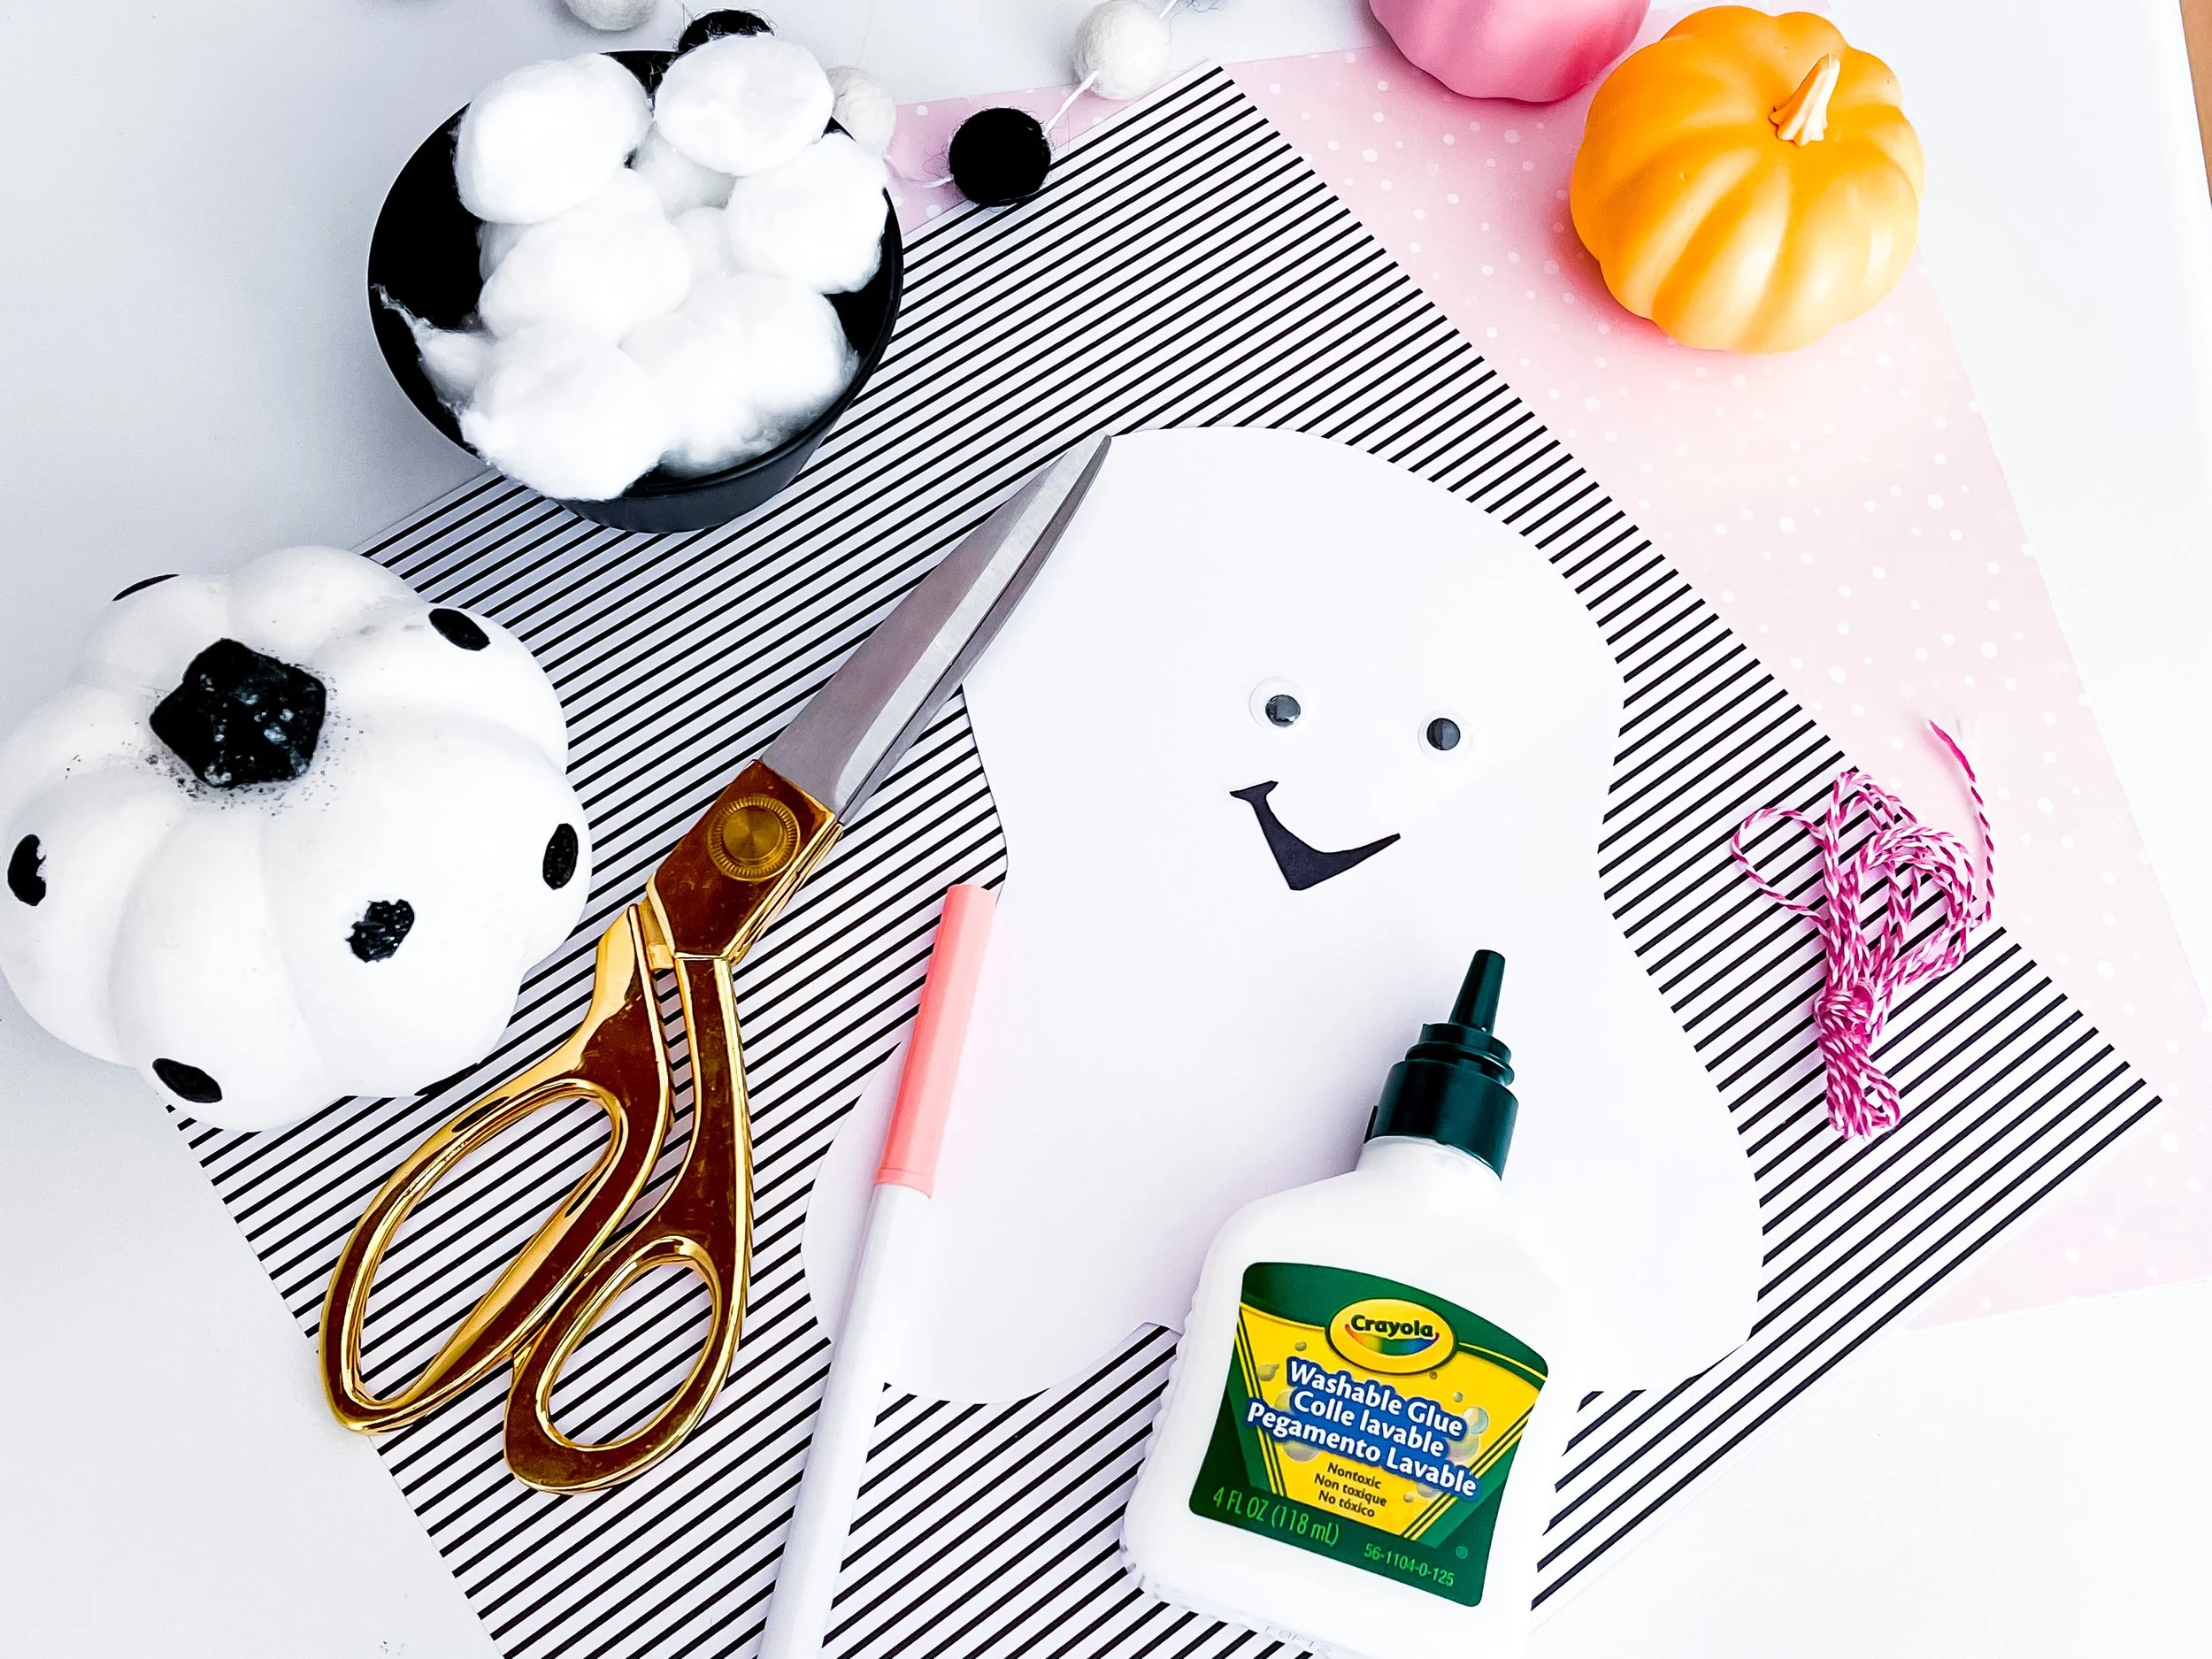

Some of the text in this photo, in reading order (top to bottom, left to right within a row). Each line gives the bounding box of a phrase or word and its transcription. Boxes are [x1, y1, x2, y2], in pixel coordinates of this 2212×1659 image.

[1350, 1314, 1434, 1337] Crayola
[1290, 1360, 1463, 1438] Washable Glue
[1294, 1390, 1445, 1458] Colle lavable
[1247, 1402, 1477, 1497] Pegamento Lavable
[1314, 1473, 1387, 1507] Non toxique
[1326, 1462, 1381, 1490] Nontoxic
[1213, 1486, 1340, 1548] 4 FL OZ (118 mL)
[1318, 1489, 1376, 1518] No tóxico
[1363, 1542, 1455, 1586] 56-1104-0-125
